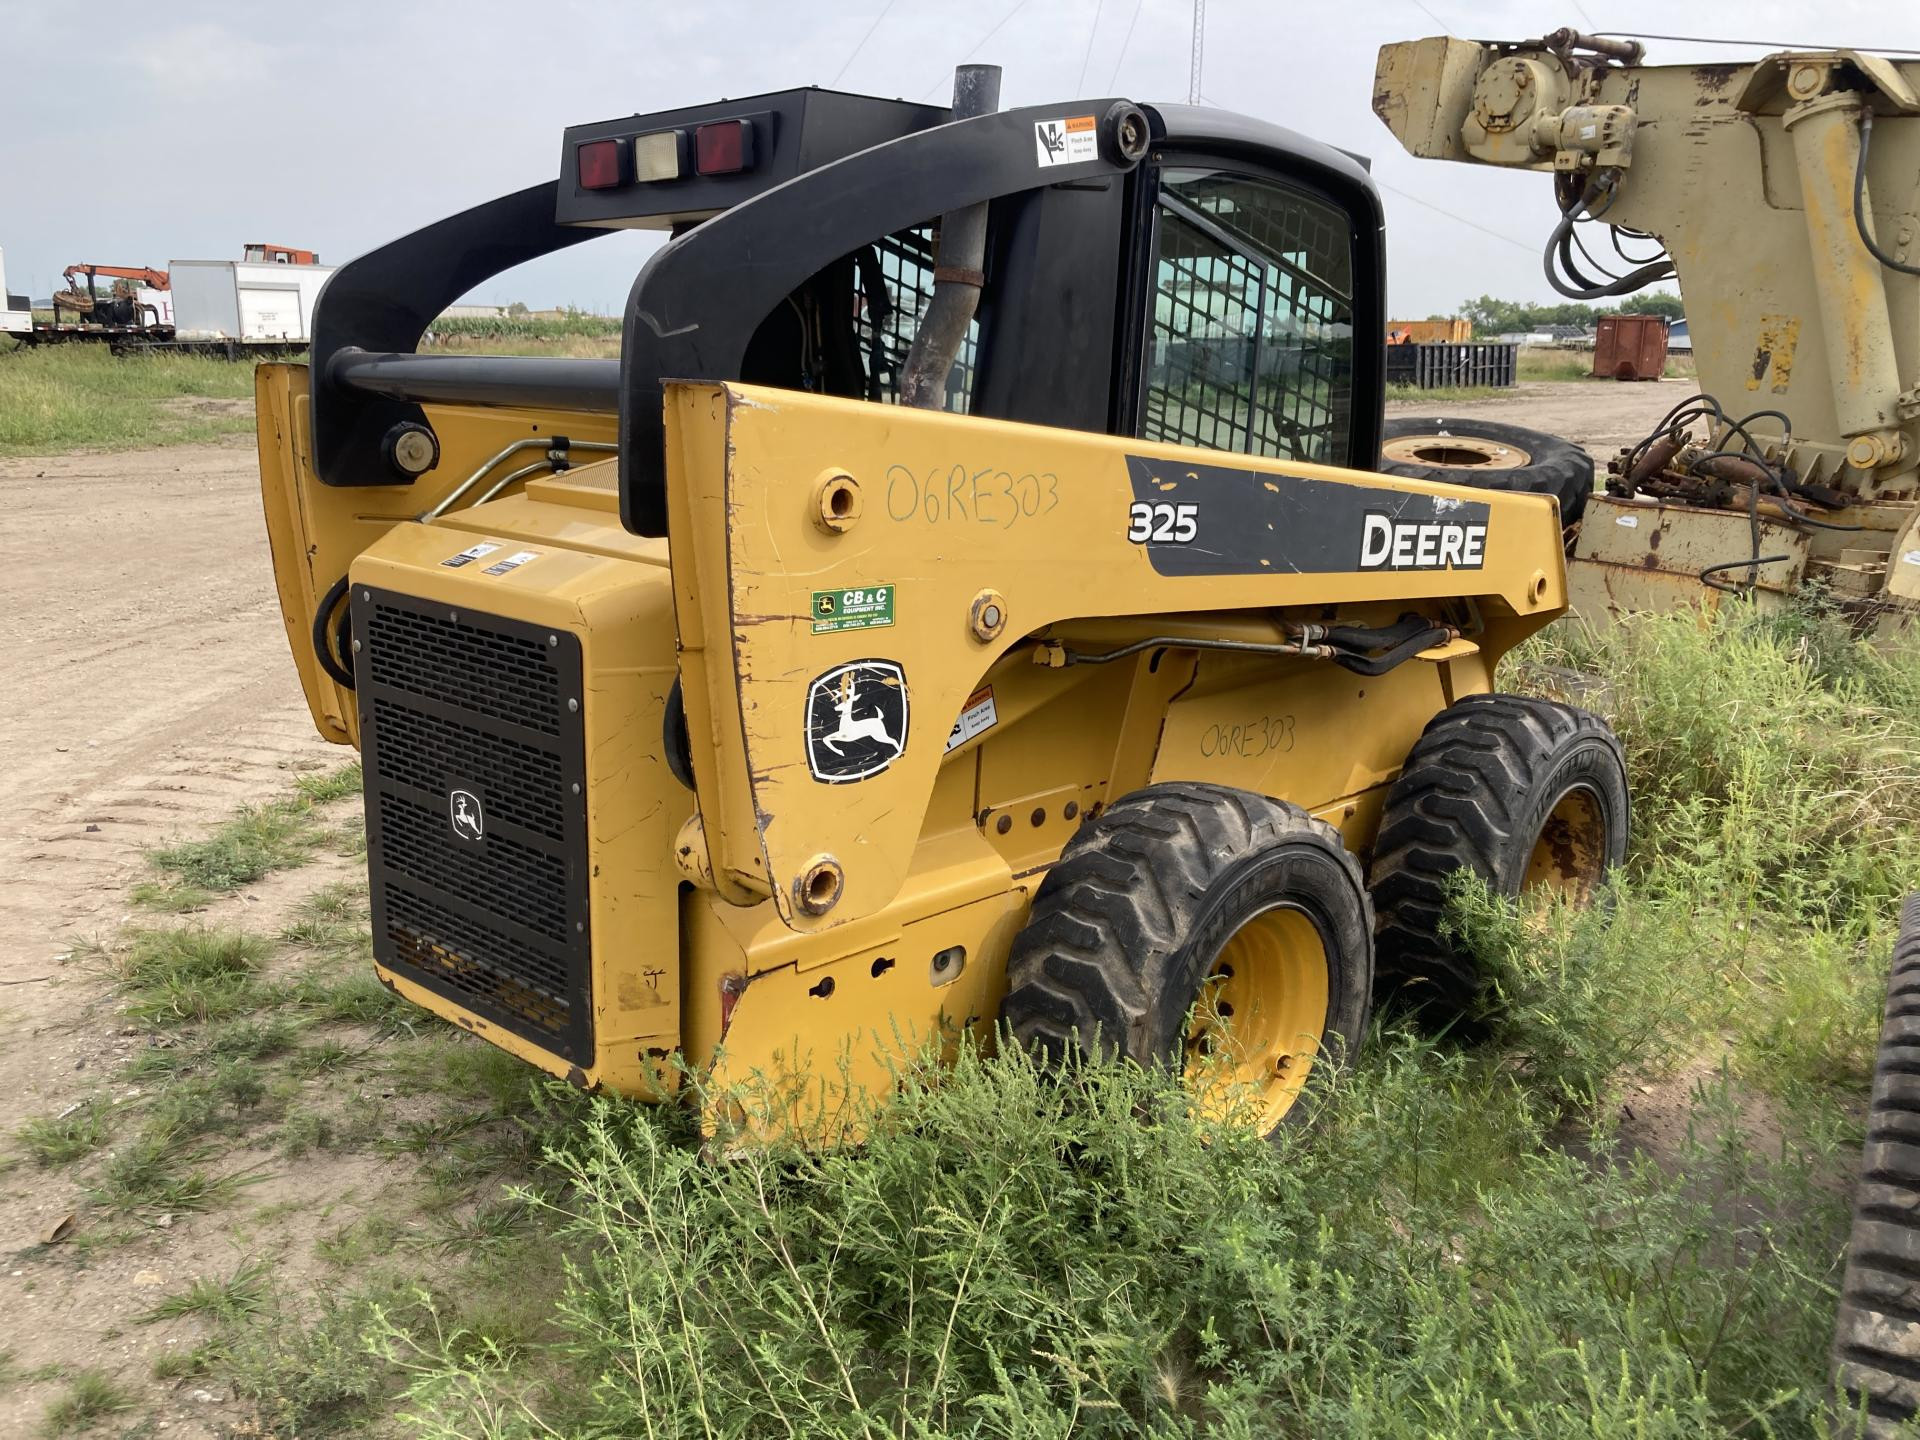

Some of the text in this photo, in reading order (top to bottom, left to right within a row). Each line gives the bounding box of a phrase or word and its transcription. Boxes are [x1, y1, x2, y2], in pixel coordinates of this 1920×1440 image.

[887, 464, 1058, 530] 06RE303
[1128, 503, 1199, 542] 325
[1361, 514, 1486, 567] DEERE
[843, 588, 887, 606] CB & C
[843, 605, 874, 614] EQUIPMENT
[1201, 714, 1295, 758] 06RE303
